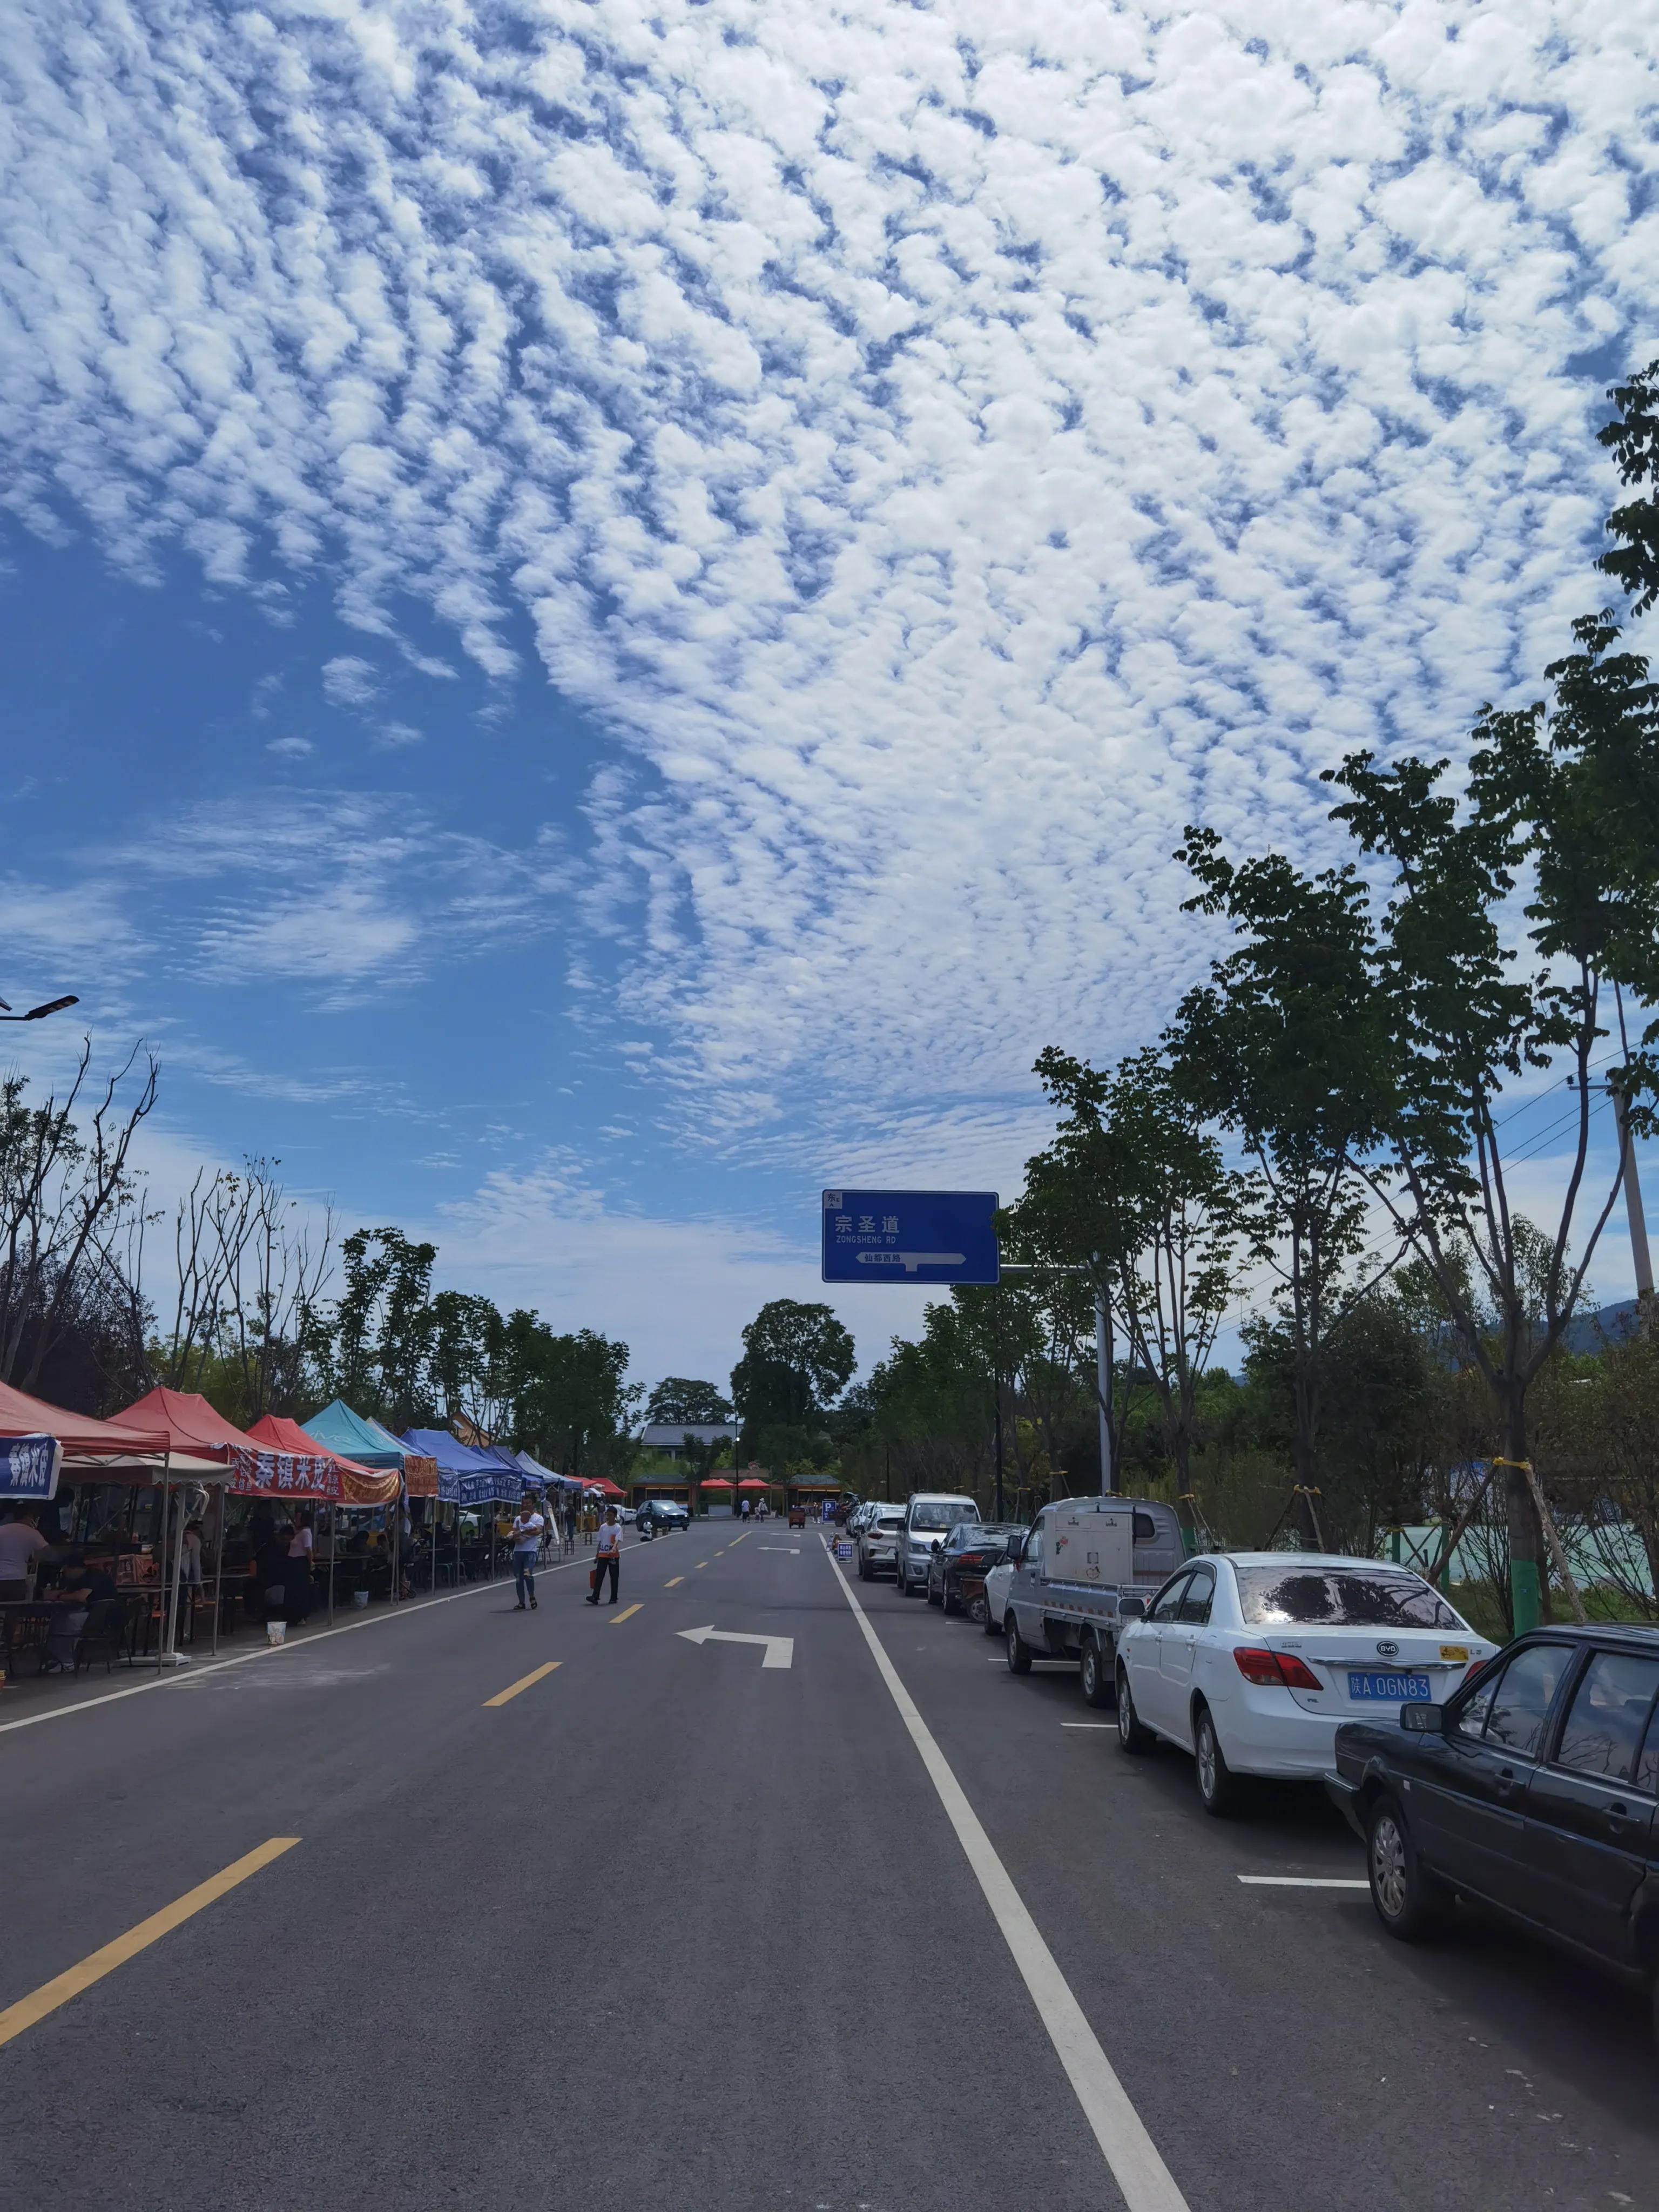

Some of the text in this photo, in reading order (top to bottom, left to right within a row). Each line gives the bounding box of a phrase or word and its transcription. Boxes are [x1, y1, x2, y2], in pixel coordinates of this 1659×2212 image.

[827, 1193, 836, 1202] 东
[835, 1215, 900, 1233] 宗圣道
[836, 1235, 896, 1244] ZONGSHENG RD
[865, 1253, 901, 1262] 仙都西路
[9, 1440, 49, 1487] 秦镇米皮
[255, 1452, 326, 1491] 秦镇米皮
[825, 1503, 831, 1512] P
